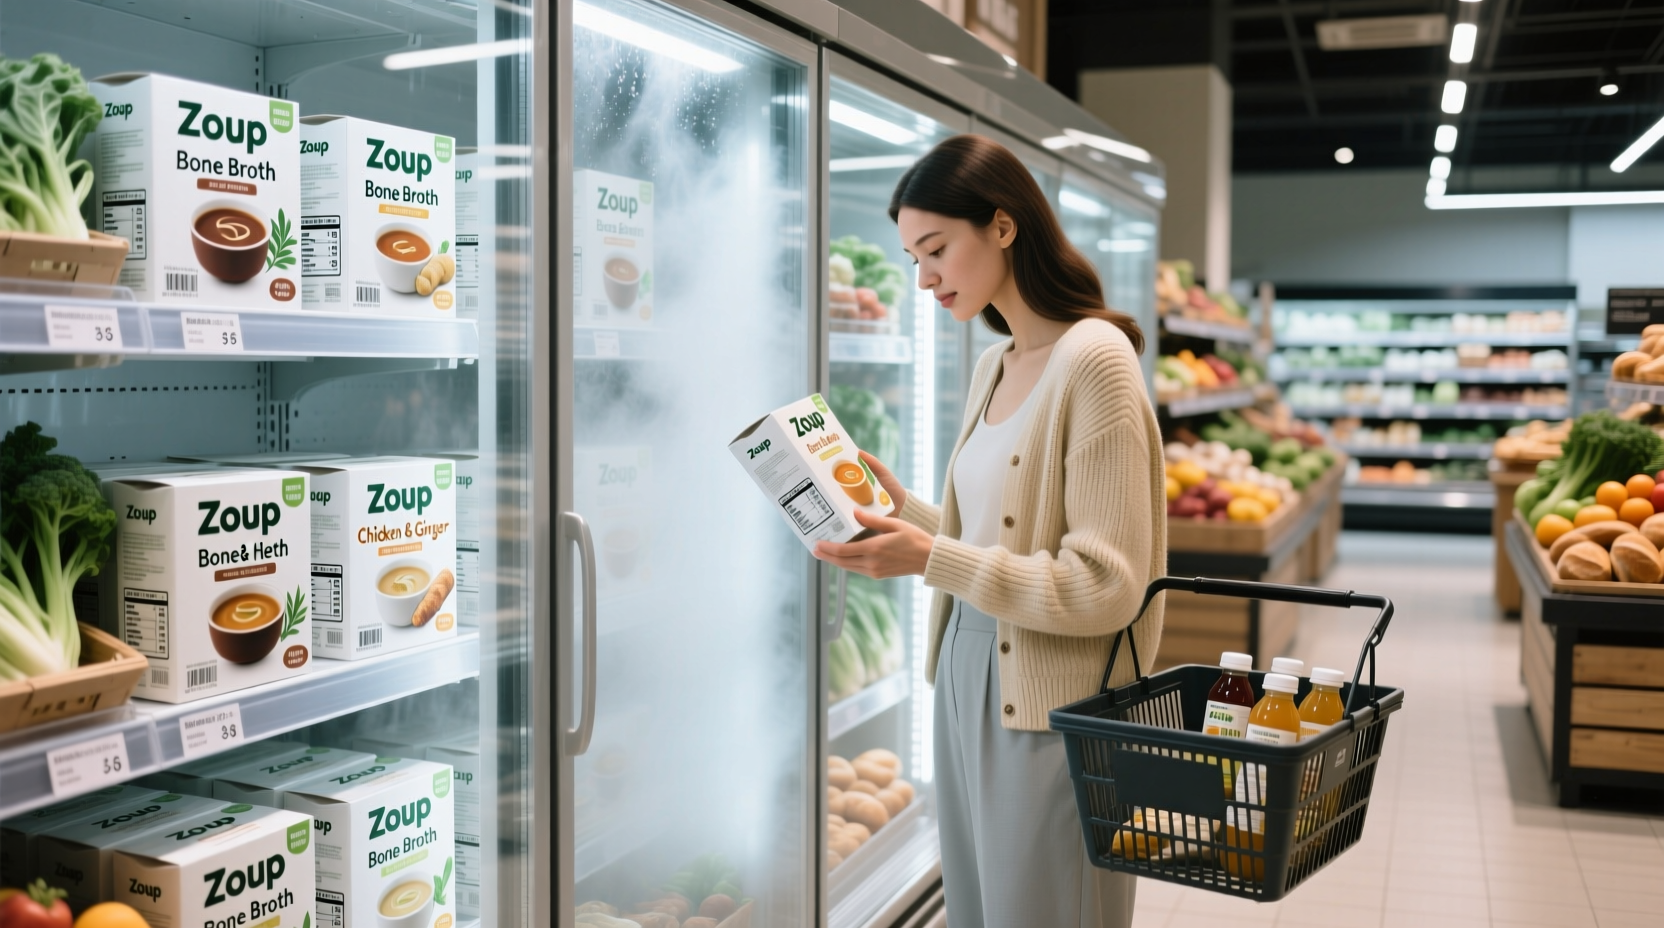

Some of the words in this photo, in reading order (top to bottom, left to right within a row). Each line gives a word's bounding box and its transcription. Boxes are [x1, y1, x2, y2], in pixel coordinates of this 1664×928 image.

[105, 102, 133, 120] Zoup
[177, 100, 267, 154] Zoup
[300, 140, 329, 156] Zoup
[366, 137, 432, 182] Zoup
[176, 150, 223, 175] Bone
[228, 157, 276, 181] Broth
[365, 179, 400, 202] Bone
[403, 186, 439, 206] Broth
[597, 187, 638, 219] Zoup
[789, 411, 825, 437] Zoup
[598, 463, 638, 488] Zoup
[310, 491, 331, 506] oup
[367, 483, 433, 516] Zoup
[126, 505, 157, 525] Zoup
[198, 500, 281, 536] Zoup
[357, 524, 402, 544] Chicken
[253, 538, 289, 561] Heth
[368, 797, 431, 840] Zoup
[368, 846, 400, 869] Bone
[403, 827, 437, 853] Broth
[129, 878, 162, 903] Zoup
[203, 853, 286, 909] Zoup
[251, 888, 294, 920] Broth
